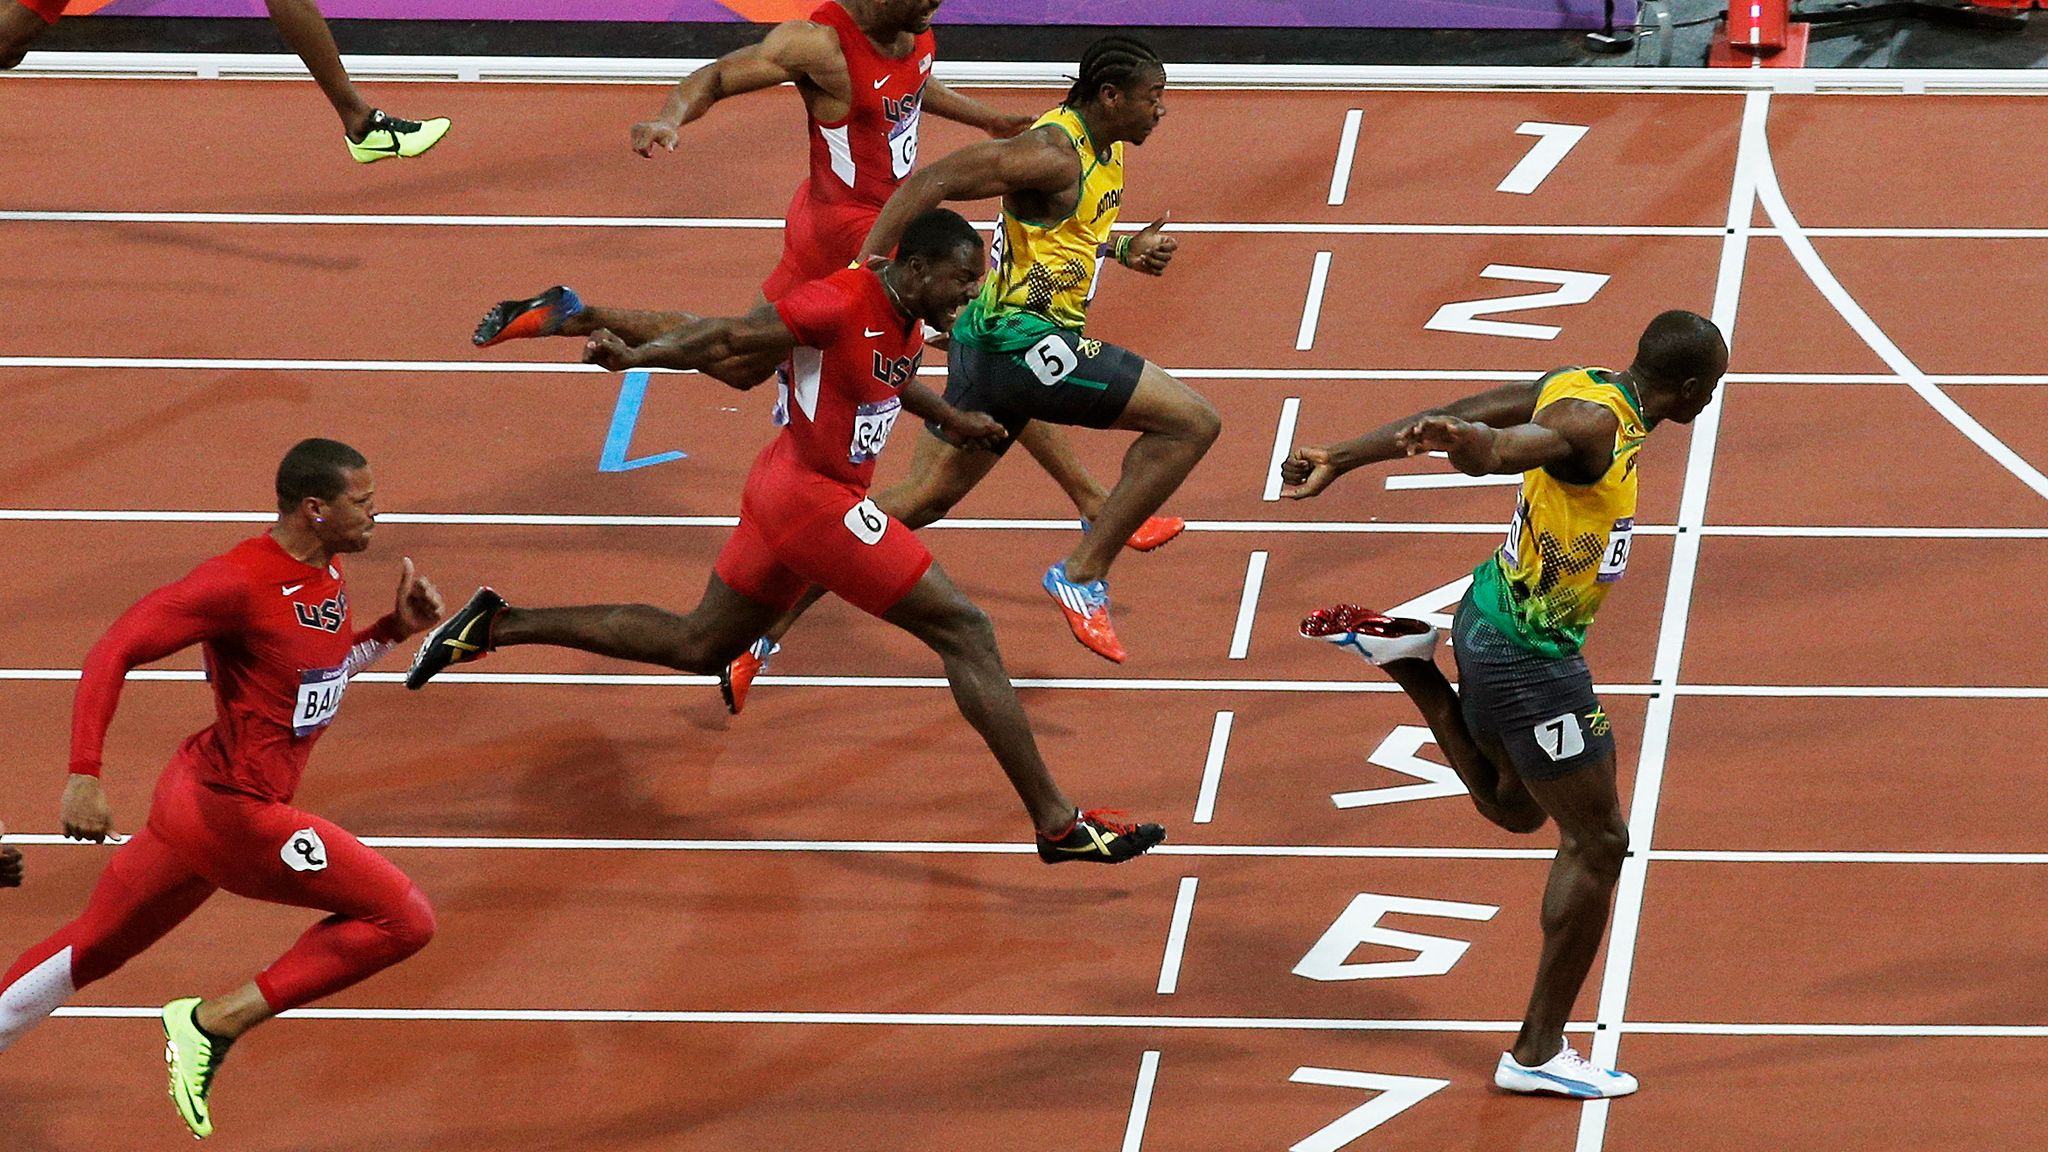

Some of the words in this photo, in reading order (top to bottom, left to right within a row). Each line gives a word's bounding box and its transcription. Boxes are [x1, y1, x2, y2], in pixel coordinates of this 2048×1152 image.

[1495, 121, 1590, 195] 1
[1423, 264, 1611, 341] 2
[1037, 343, 1064, 377] 5
[858, 505, 882, 533] 6
[1609, 538, 1627, 567] B
[1545, 719, 1564, 756] 7
[1291, 892, 1500, 981] 6
[1288, 1066, 1451, 1152] 7
